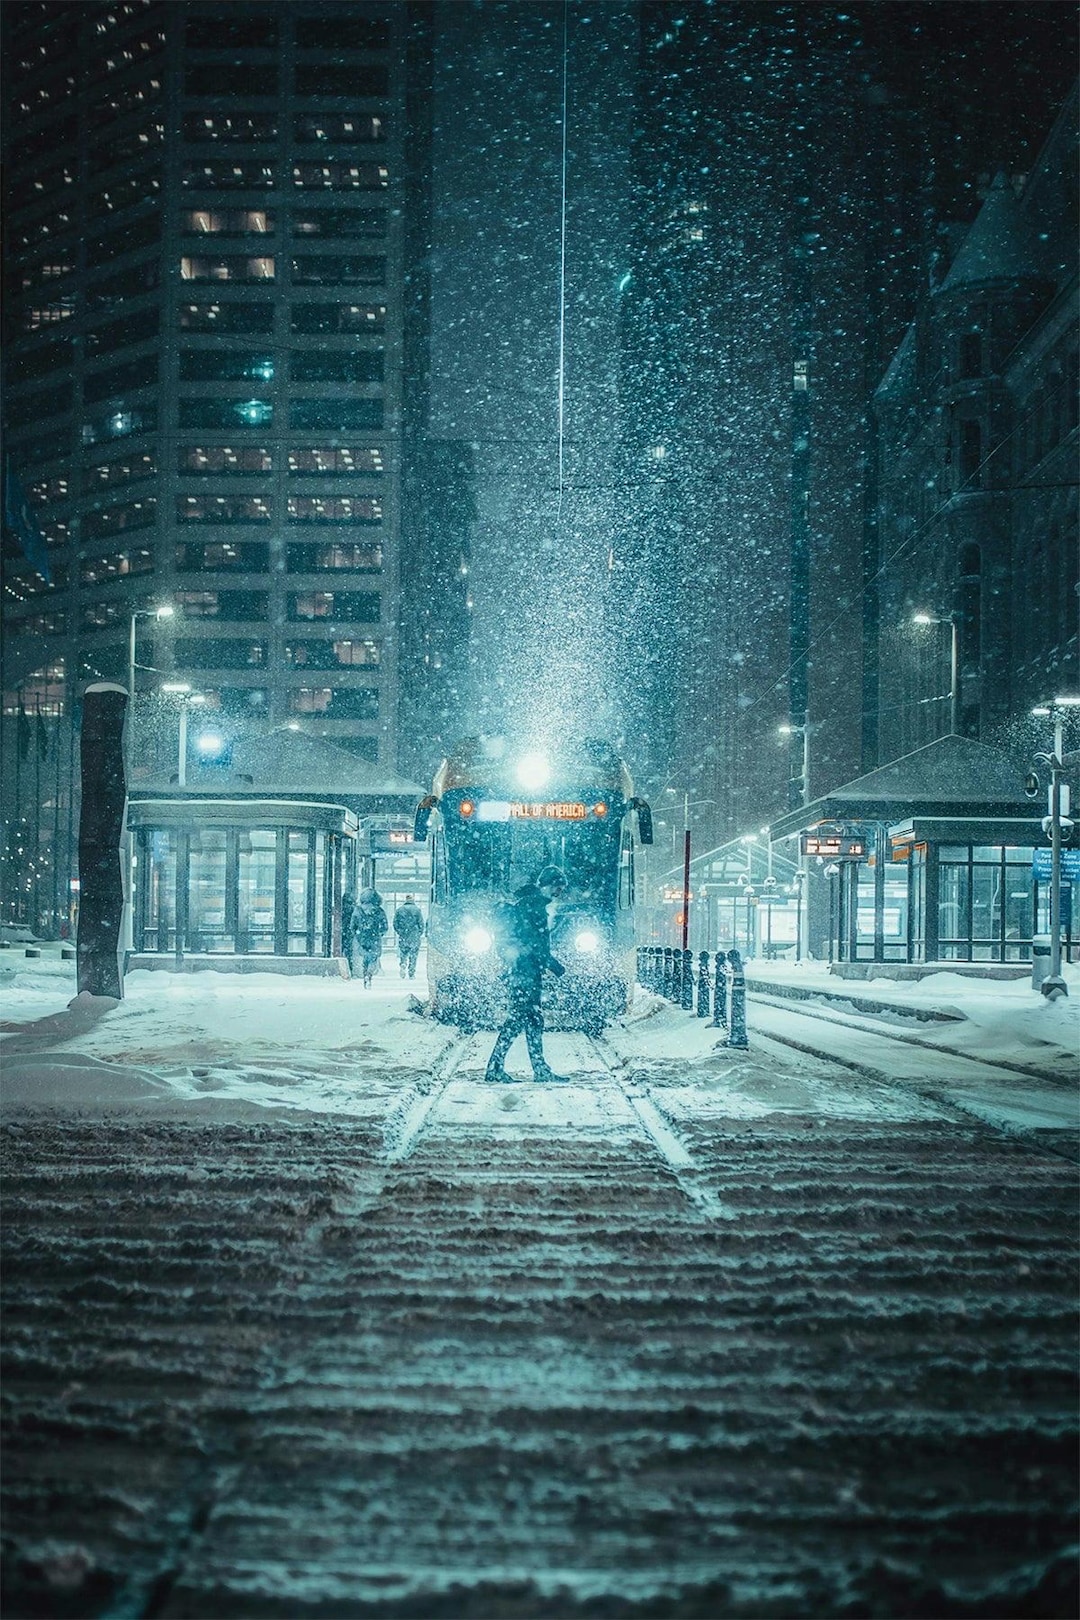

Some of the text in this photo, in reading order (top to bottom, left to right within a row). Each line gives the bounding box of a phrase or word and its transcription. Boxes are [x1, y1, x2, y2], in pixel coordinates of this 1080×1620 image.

[508, 803, 584, 817] MALL OF AMERICA
